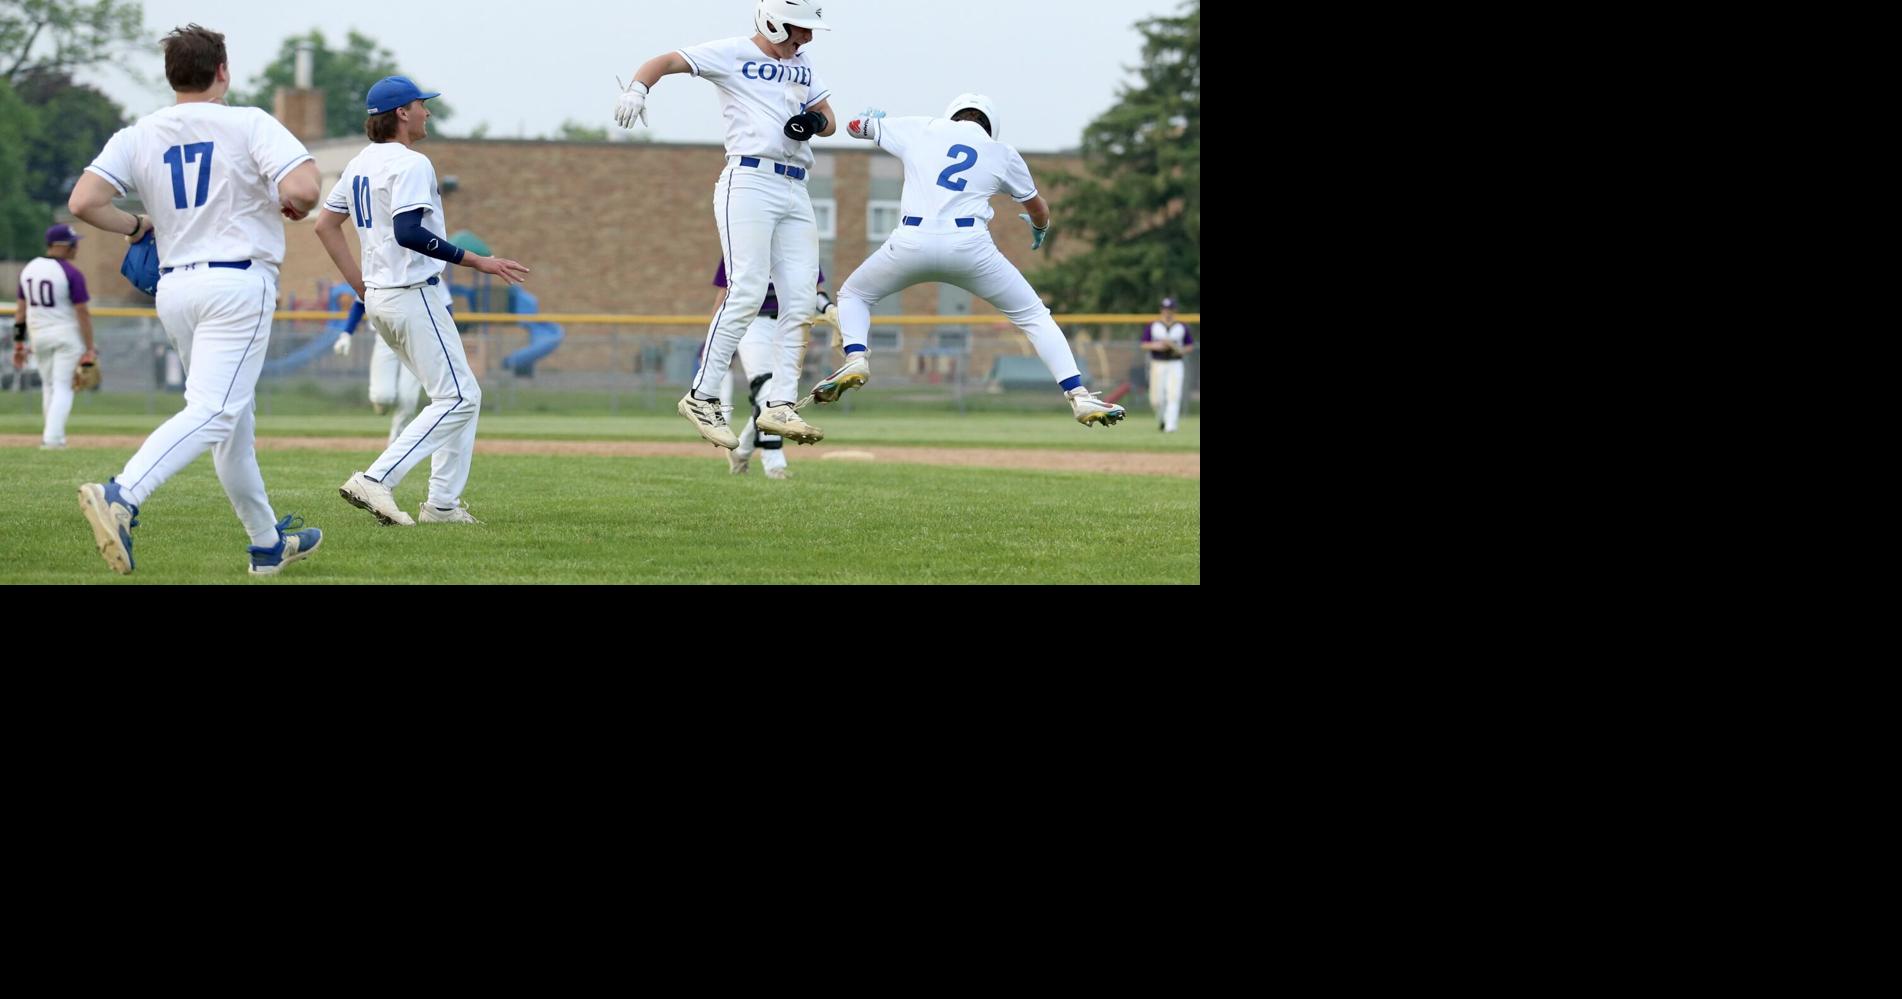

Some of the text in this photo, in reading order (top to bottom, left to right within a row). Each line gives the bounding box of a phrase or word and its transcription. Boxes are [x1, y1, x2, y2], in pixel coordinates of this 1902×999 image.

[163, 141, 214, 209] 17
[936, 143, 978, 192] 2
[352, 174, 373, 229] 10
[27, 279, 55, 308] 10
